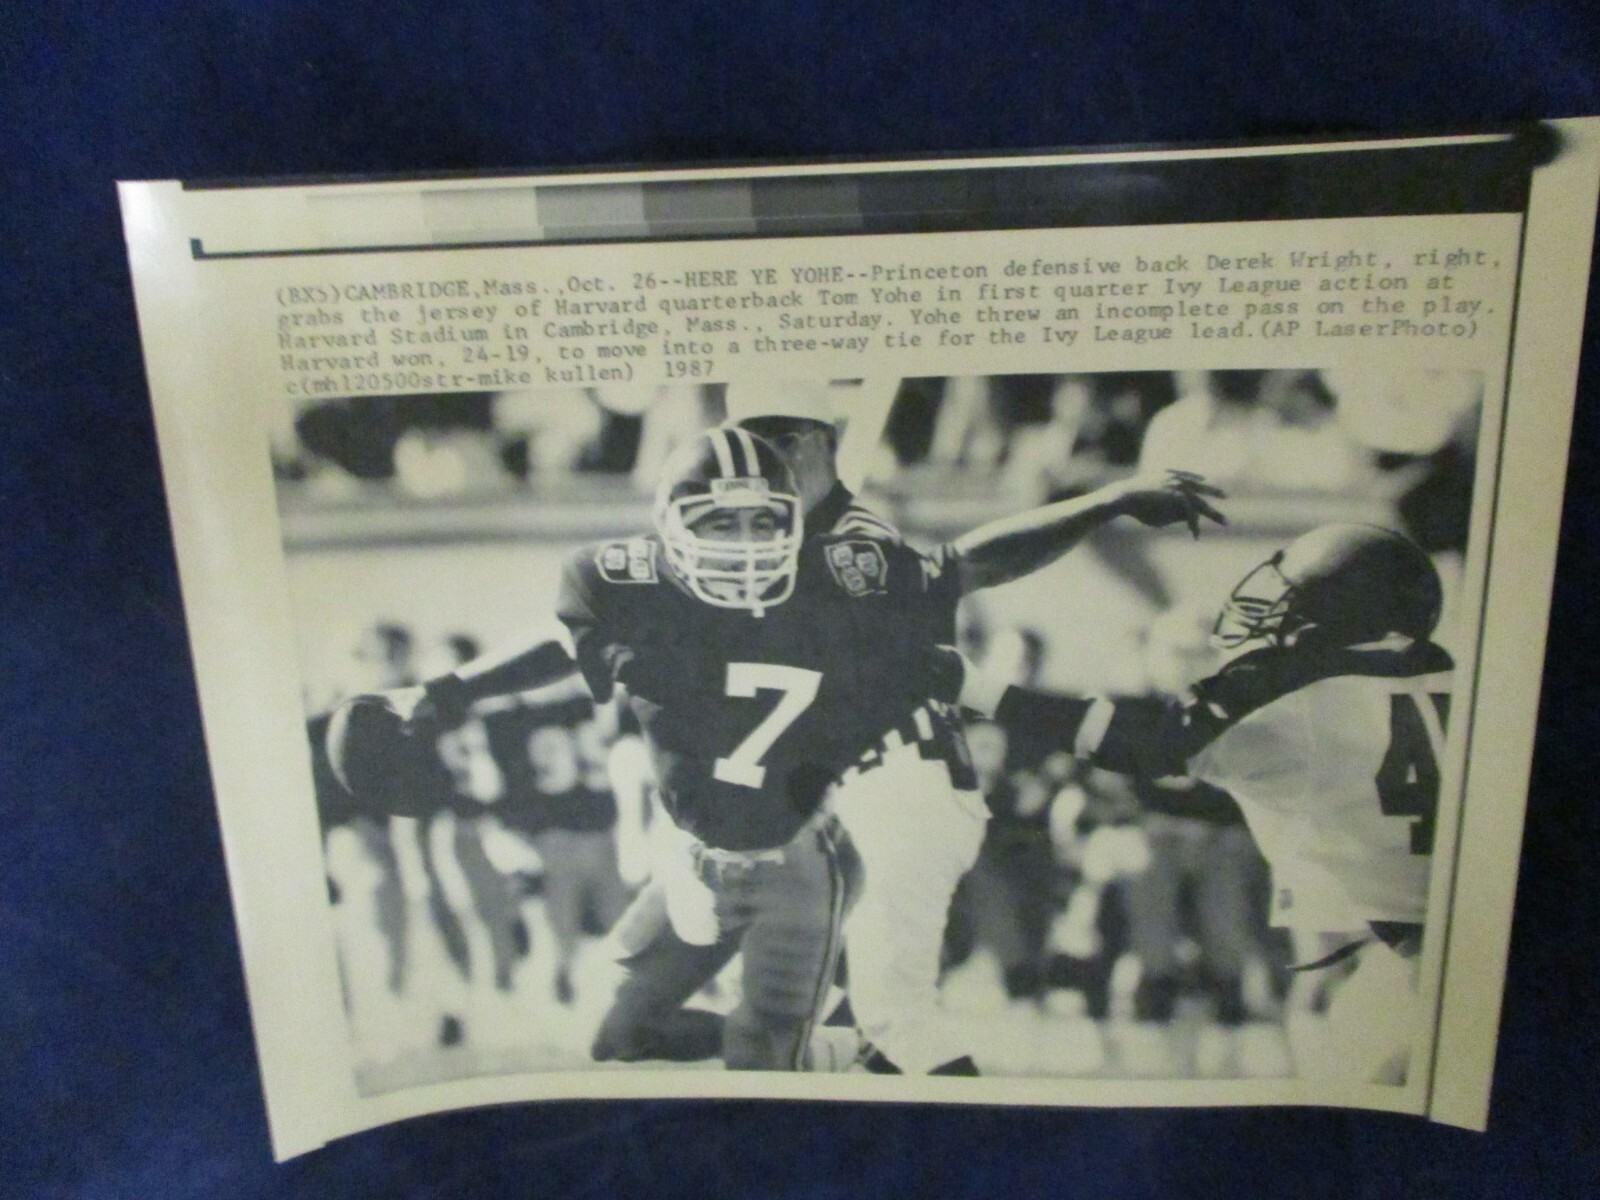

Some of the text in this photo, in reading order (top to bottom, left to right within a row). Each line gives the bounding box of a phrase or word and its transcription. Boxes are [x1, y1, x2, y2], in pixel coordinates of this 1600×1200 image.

[751, 269, 777, 285] YE
[1004, 258, 1121, 277] defensive
[1136, 254, 1189, 273] back
[1207, 253, 1273, 271] Derek
[277, 273, 1454, 330] grabs the jersey of Harvard quarterback Tom Yohe in first quarter Ivy League action at
[278, 329, 377, 349] Harvard
[391, 323, 489, 344] Stadium
[504, 322, 528, 340] in
[910, 307, 961, 325] Yohe
[976, 305, 1040, 323] threw
[1055, 306, 1079, 320] an
[1096, 301, 1229, 322] incomplete
[1245, 301, 1299, 320] pass
[1317, 299, 1344, 315] on
[1363, 296, 1405, 314] the
[280, 351, 379, 372] Harvard
[559, 344, 584, 360] to
[600, 344, 646, 358] move
[663, 339, 713, 356] into
[728, 340, 740, 354] a
[754, 335, 869, 353] three-way
[885, 330, 922, 348] tie
[939, 329, 975, 347] for
[989, 326, 1026, 345] the
[1042, 326, 1079, 347] Ivy
[1094, 325, 1173, 345] League
[1316, 319, 1478, 339] LaserPhoto)
[544, 362, 634, 383] kullen)
[665, 359, 714, 379] 1987
[713, 662, 823, 788] 7
